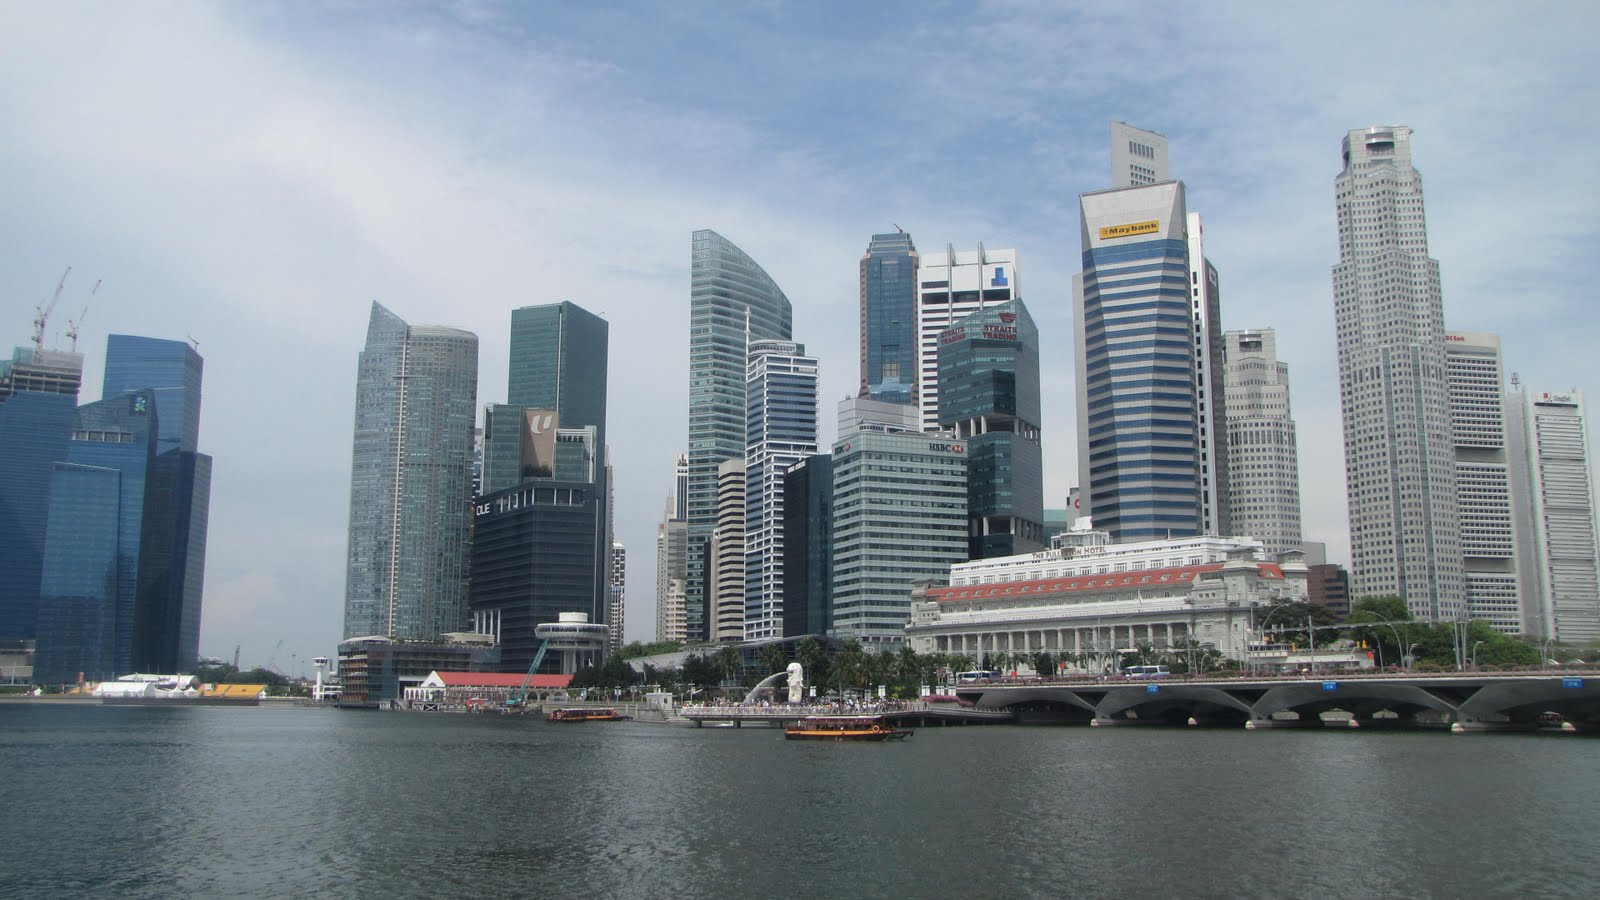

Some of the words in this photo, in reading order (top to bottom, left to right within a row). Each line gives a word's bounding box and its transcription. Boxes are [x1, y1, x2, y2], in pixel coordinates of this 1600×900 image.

[1109, 223, 1157, 234] Maybank
[984, 324, 1017, 333] STRAITS
[982, 331, 1017, 340] TRADING
[929, 443, 951, 452] HSBC
[476, 502, 490, 516] OUE
[1032, 552, 1044, 560] THE
